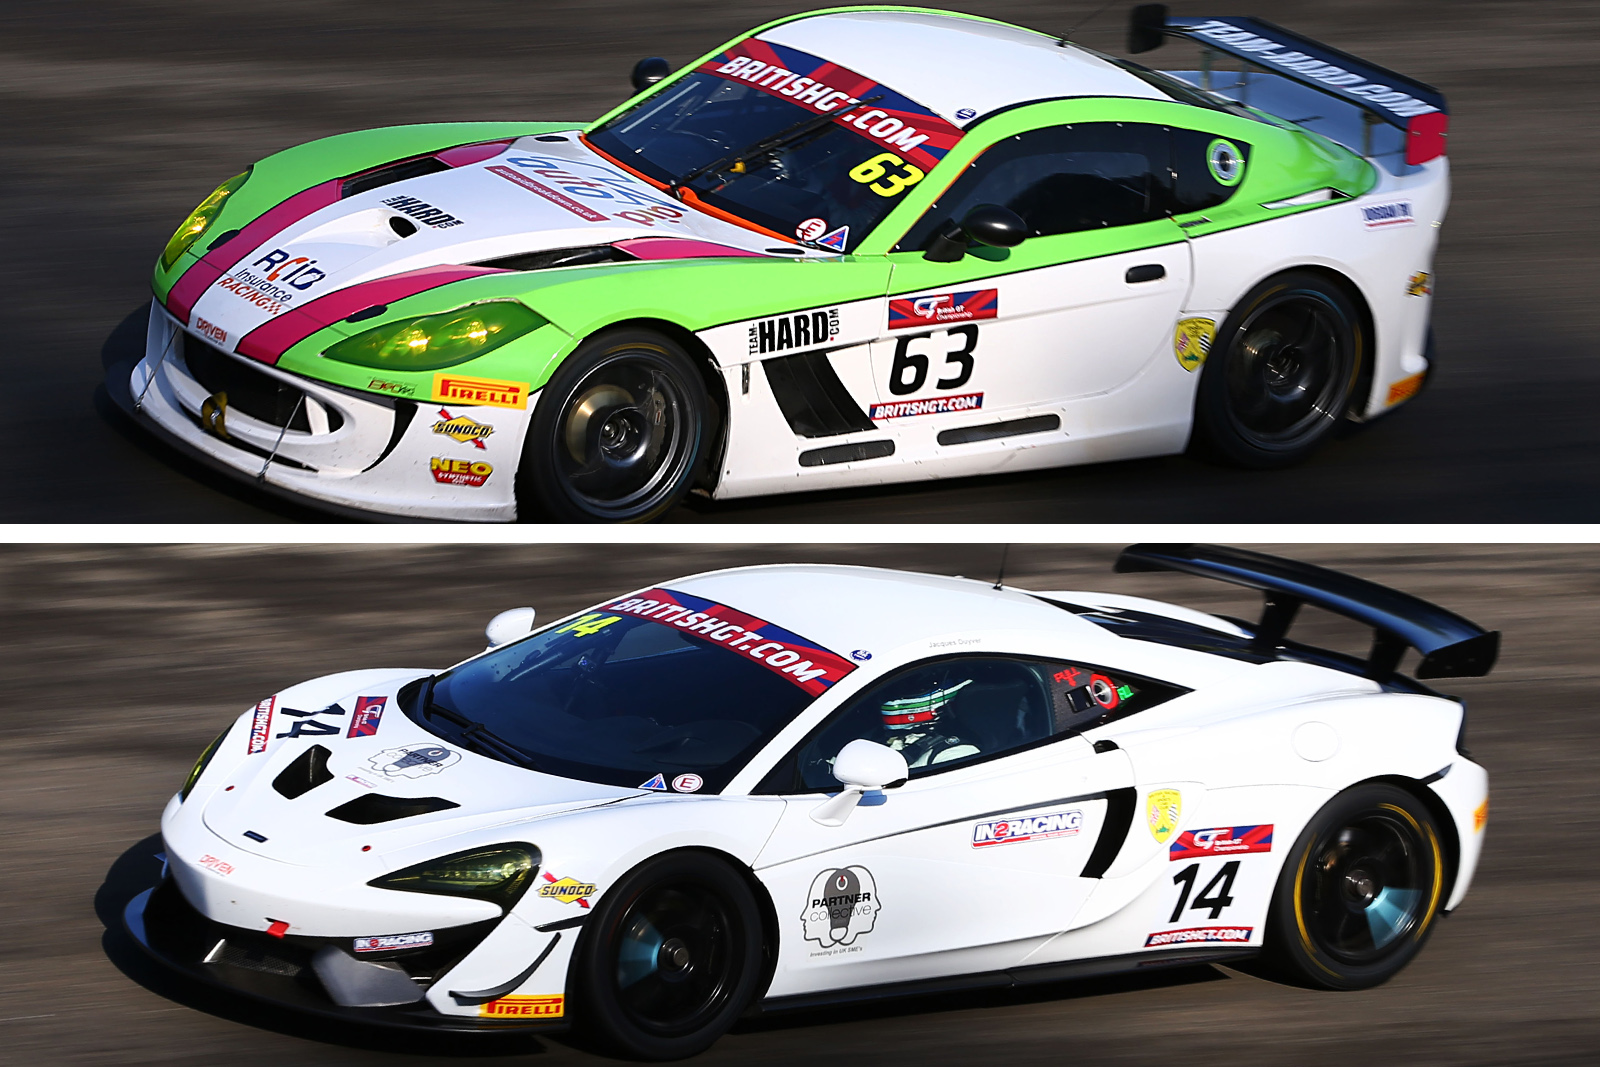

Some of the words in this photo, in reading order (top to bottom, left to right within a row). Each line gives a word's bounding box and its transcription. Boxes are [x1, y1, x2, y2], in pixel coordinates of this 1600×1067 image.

[849, 153, 925, 197] 63
[386, 197, 456, 226] HARD
[216, 277, 273, 307] RACING
[234, 267, 293, 303] Insurance
[195, 317, 228, 342] DRIVEN
[758, 311, 829, 354] HARD
[889, 323, 979, 396] 63
[439, 379, 521, 405] PIRELLI
[873, 395, 978, 420] BRITISHGT.COM
[435, 422, 491, 439] SUNOCO
[430, 457, 493, 476] NEO
[554, 612, 623, 638] 14
[608, 597, 828, 684] BRITISHGT.COM
[275, 703, 346, 739] 14
[679, 777, 696, 789] E
[976, 811, 1082, 842] IN2RACING
[541, 885, 596, 897] SUNOCO
[811, 892, 872, 908] PARTNER
[1168, 860, 1241, 923] 14
[809, 905, 872, 922] collective
[486, 997, 563, 1015] PIRELLI
